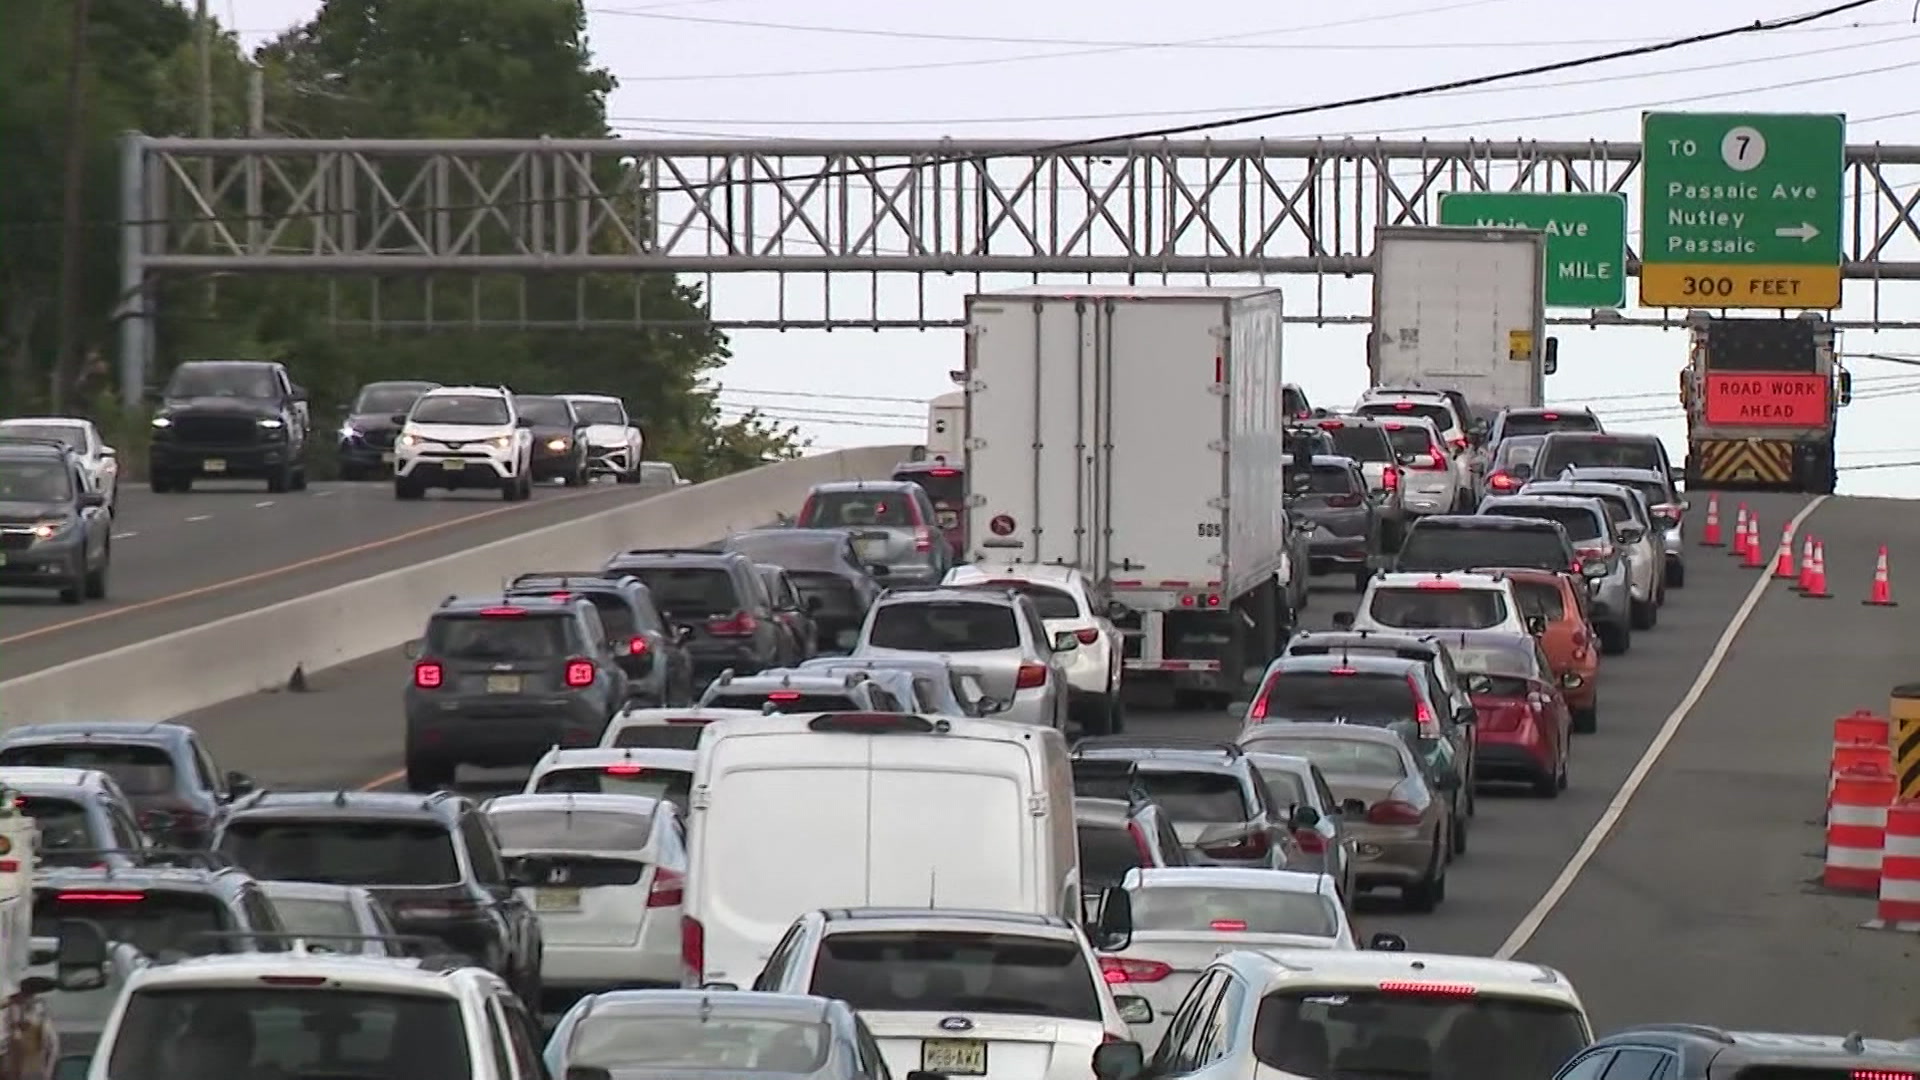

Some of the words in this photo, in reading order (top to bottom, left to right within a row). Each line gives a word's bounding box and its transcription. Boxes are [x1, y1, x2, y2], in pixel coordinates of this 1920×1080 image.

[1668, 140, 1697, 157] TO
[1736, 135, 1751, 161] 7
[1668, 181, 1758, 199] Passaic
[1772, 182, 1817, 199] Ave
[1545, 218, 1589, 237] Ave
[1668, 208, 1745, 229] Nutley
[1668, 235, 1756, 253] Passaic
[1559, 260, 1612, 279] MILE
[1683, 276, 1733, 297] 300
[1750, 279, 1801, 296] FEET
[1720, 382, 1762, 395] ROAD
[1772, 382, 1816, 395] WORK
[1740, 404, 1794, 418] AHEAD
